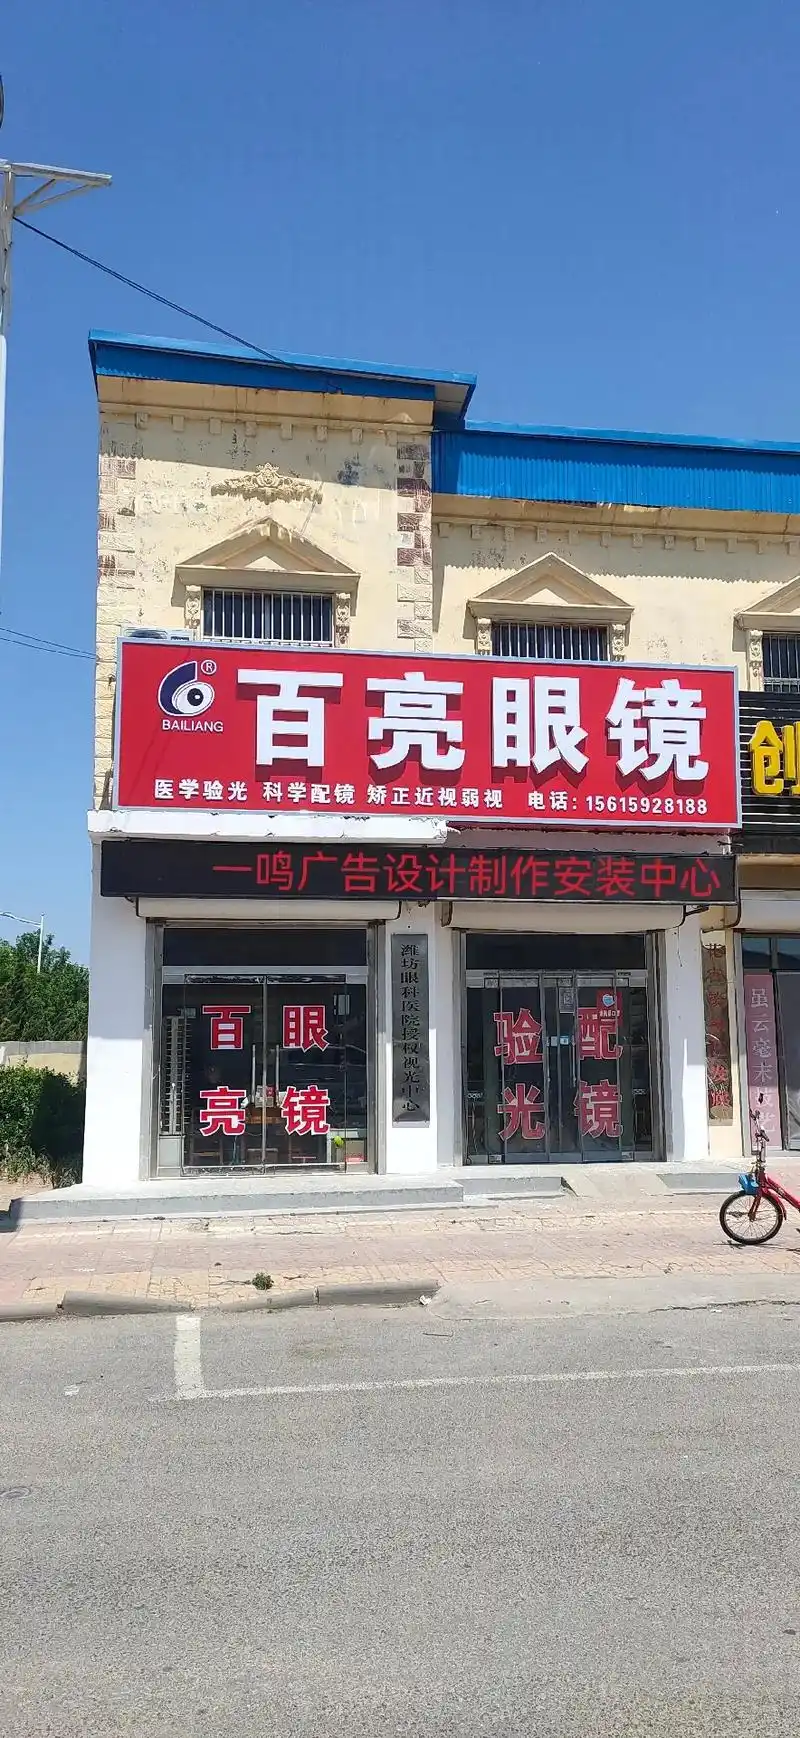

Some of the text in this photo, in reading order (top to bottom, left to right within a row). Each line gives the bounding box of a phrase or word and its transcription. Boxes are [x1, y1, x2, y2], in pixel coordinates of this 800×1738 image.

[162, 719, 224, 733] BAILIANG
[237, 669, 709, 781] 百亮眼镜
[154, 779, 248, 801] 医学验光
[263, 782, 355, 805] 科学配镜
[367, 784, 503, 809] 矫正近视弱视
[401, 944, 421, 1112] 潍坊眼科医院授权视光中心
